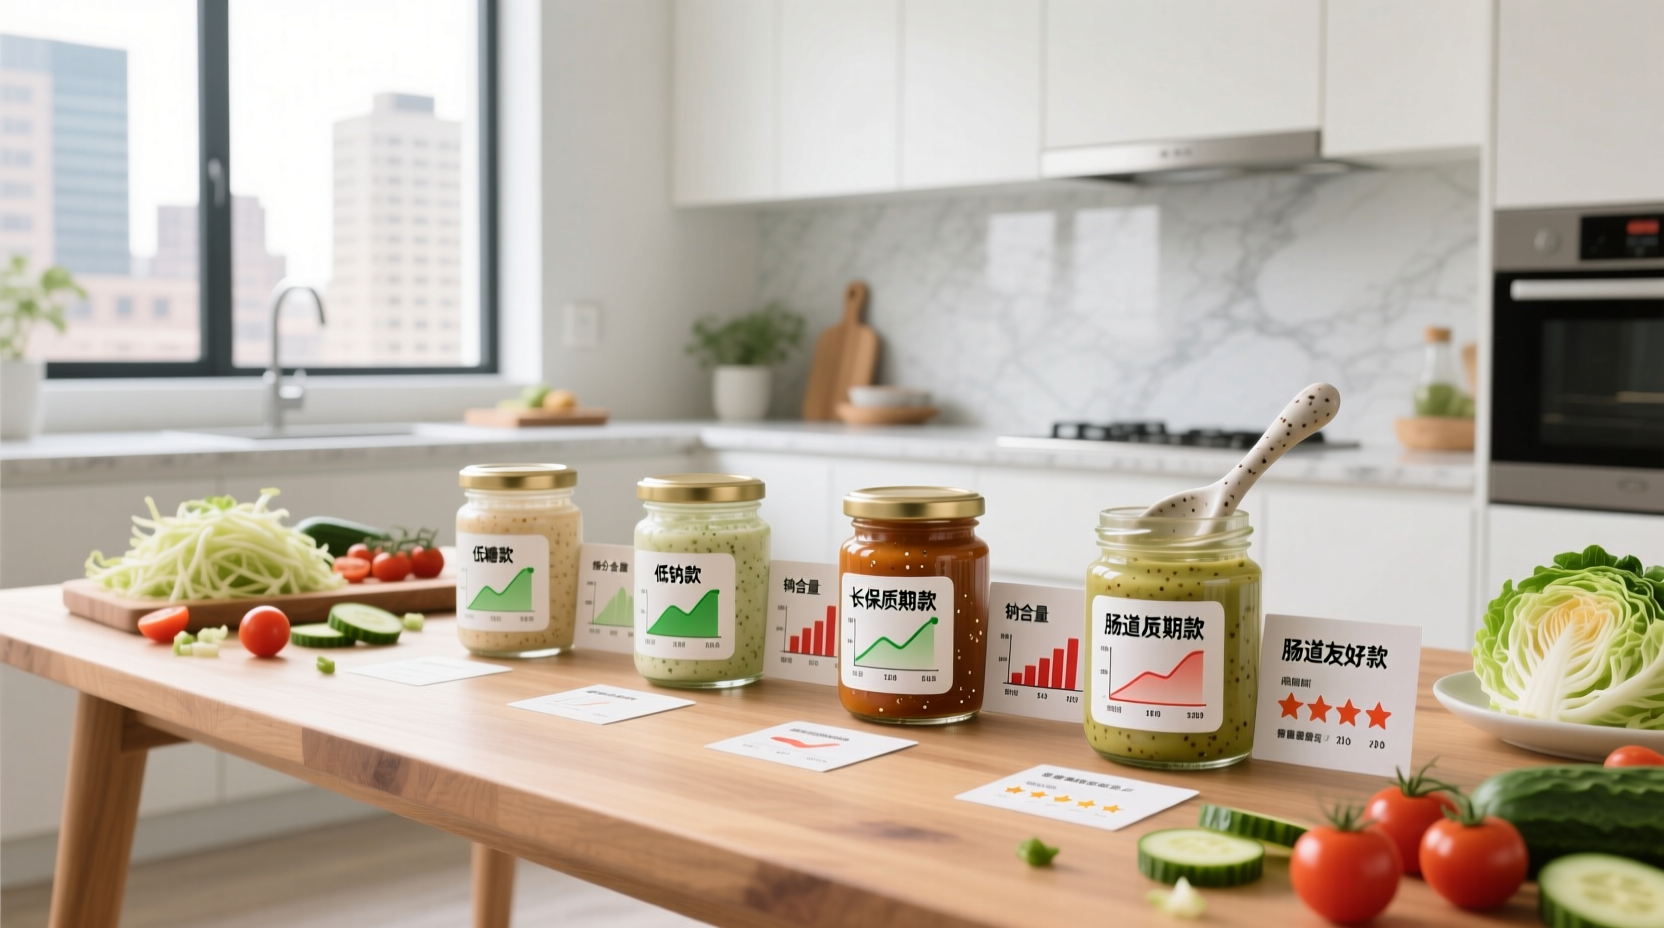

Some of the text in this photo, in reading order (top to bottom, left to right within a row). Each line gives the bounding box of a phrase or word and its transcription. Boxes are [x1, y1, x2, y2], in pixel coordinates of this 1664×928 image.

[654, 564, 701, 584] 低钠款
[849, 586, 937, 611] 长保质期款
[1281, 638, 1388, 669] 肠道友好款
